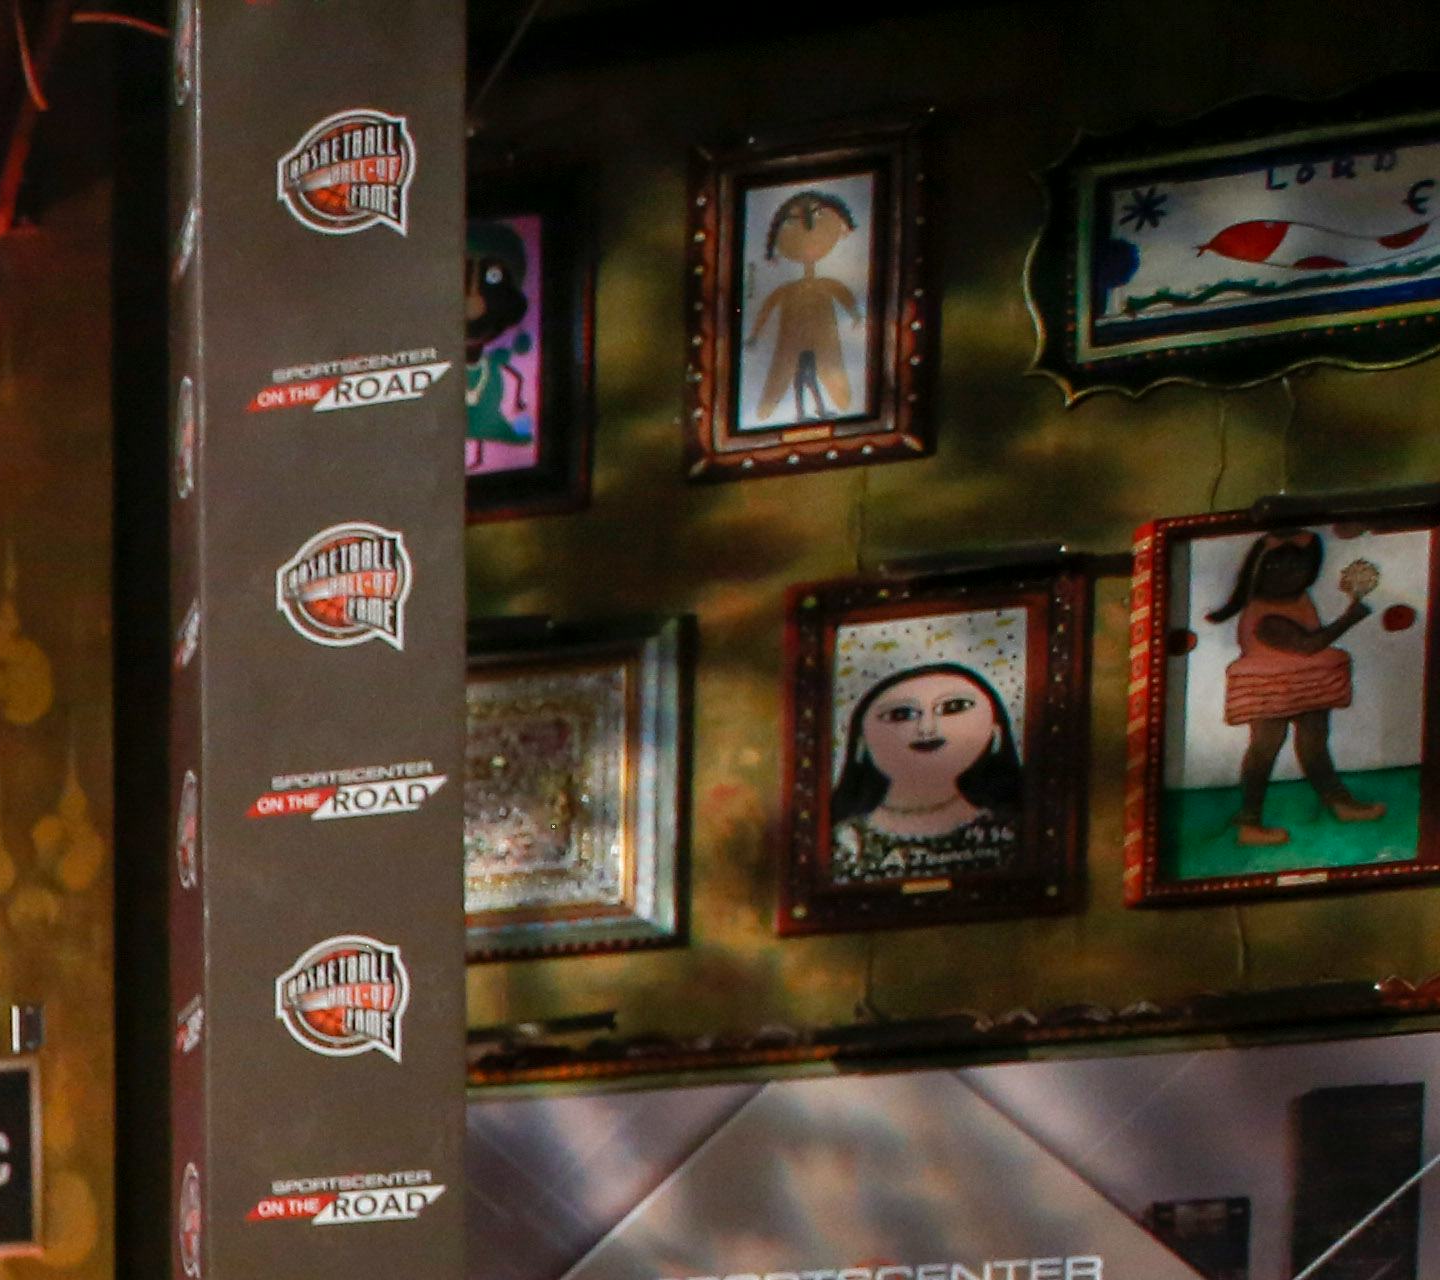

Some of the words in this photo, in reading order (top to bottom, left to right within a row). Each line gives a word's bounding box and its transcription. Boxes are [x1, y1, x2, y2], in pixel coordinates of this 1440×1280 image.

[290, 124, 397, 179] BASKETBALL
[257, 390, 284, 408] ON
[288, 386, 321, 402] THE
[334, 371, 431, 402] ROAD
[256, 797, 284, 814] ON
[288, 793, 321, 809] THE
[333, 784, 427, 813] ROAD
[257, 1200, 285, 1217] ON
[289, 1199, 320, 1215] THE
[333, 1192, 427, 1218] ROAD
